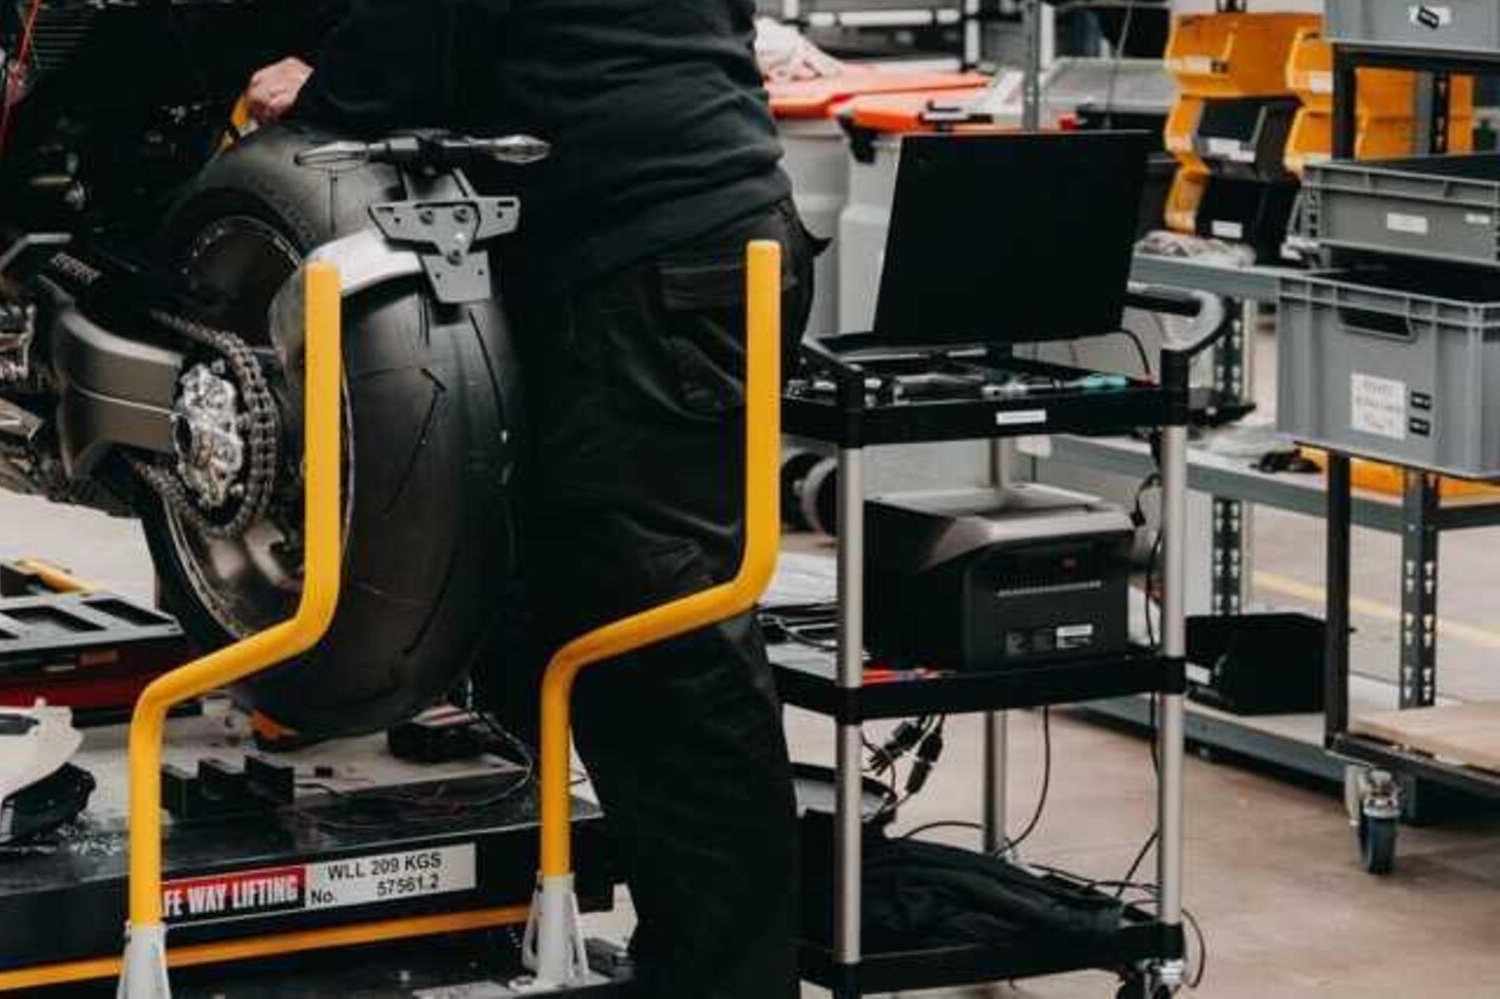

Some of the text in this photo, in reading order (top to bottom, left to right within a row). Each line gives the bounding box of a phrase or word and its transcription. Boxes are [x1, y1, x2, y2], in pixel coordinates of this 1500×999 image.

[328, 852, 441, 881] WLL 209 KGS
[163, 874, 300, 918] FE WAY LIFTING
[310, 888, 338, 905] No.
